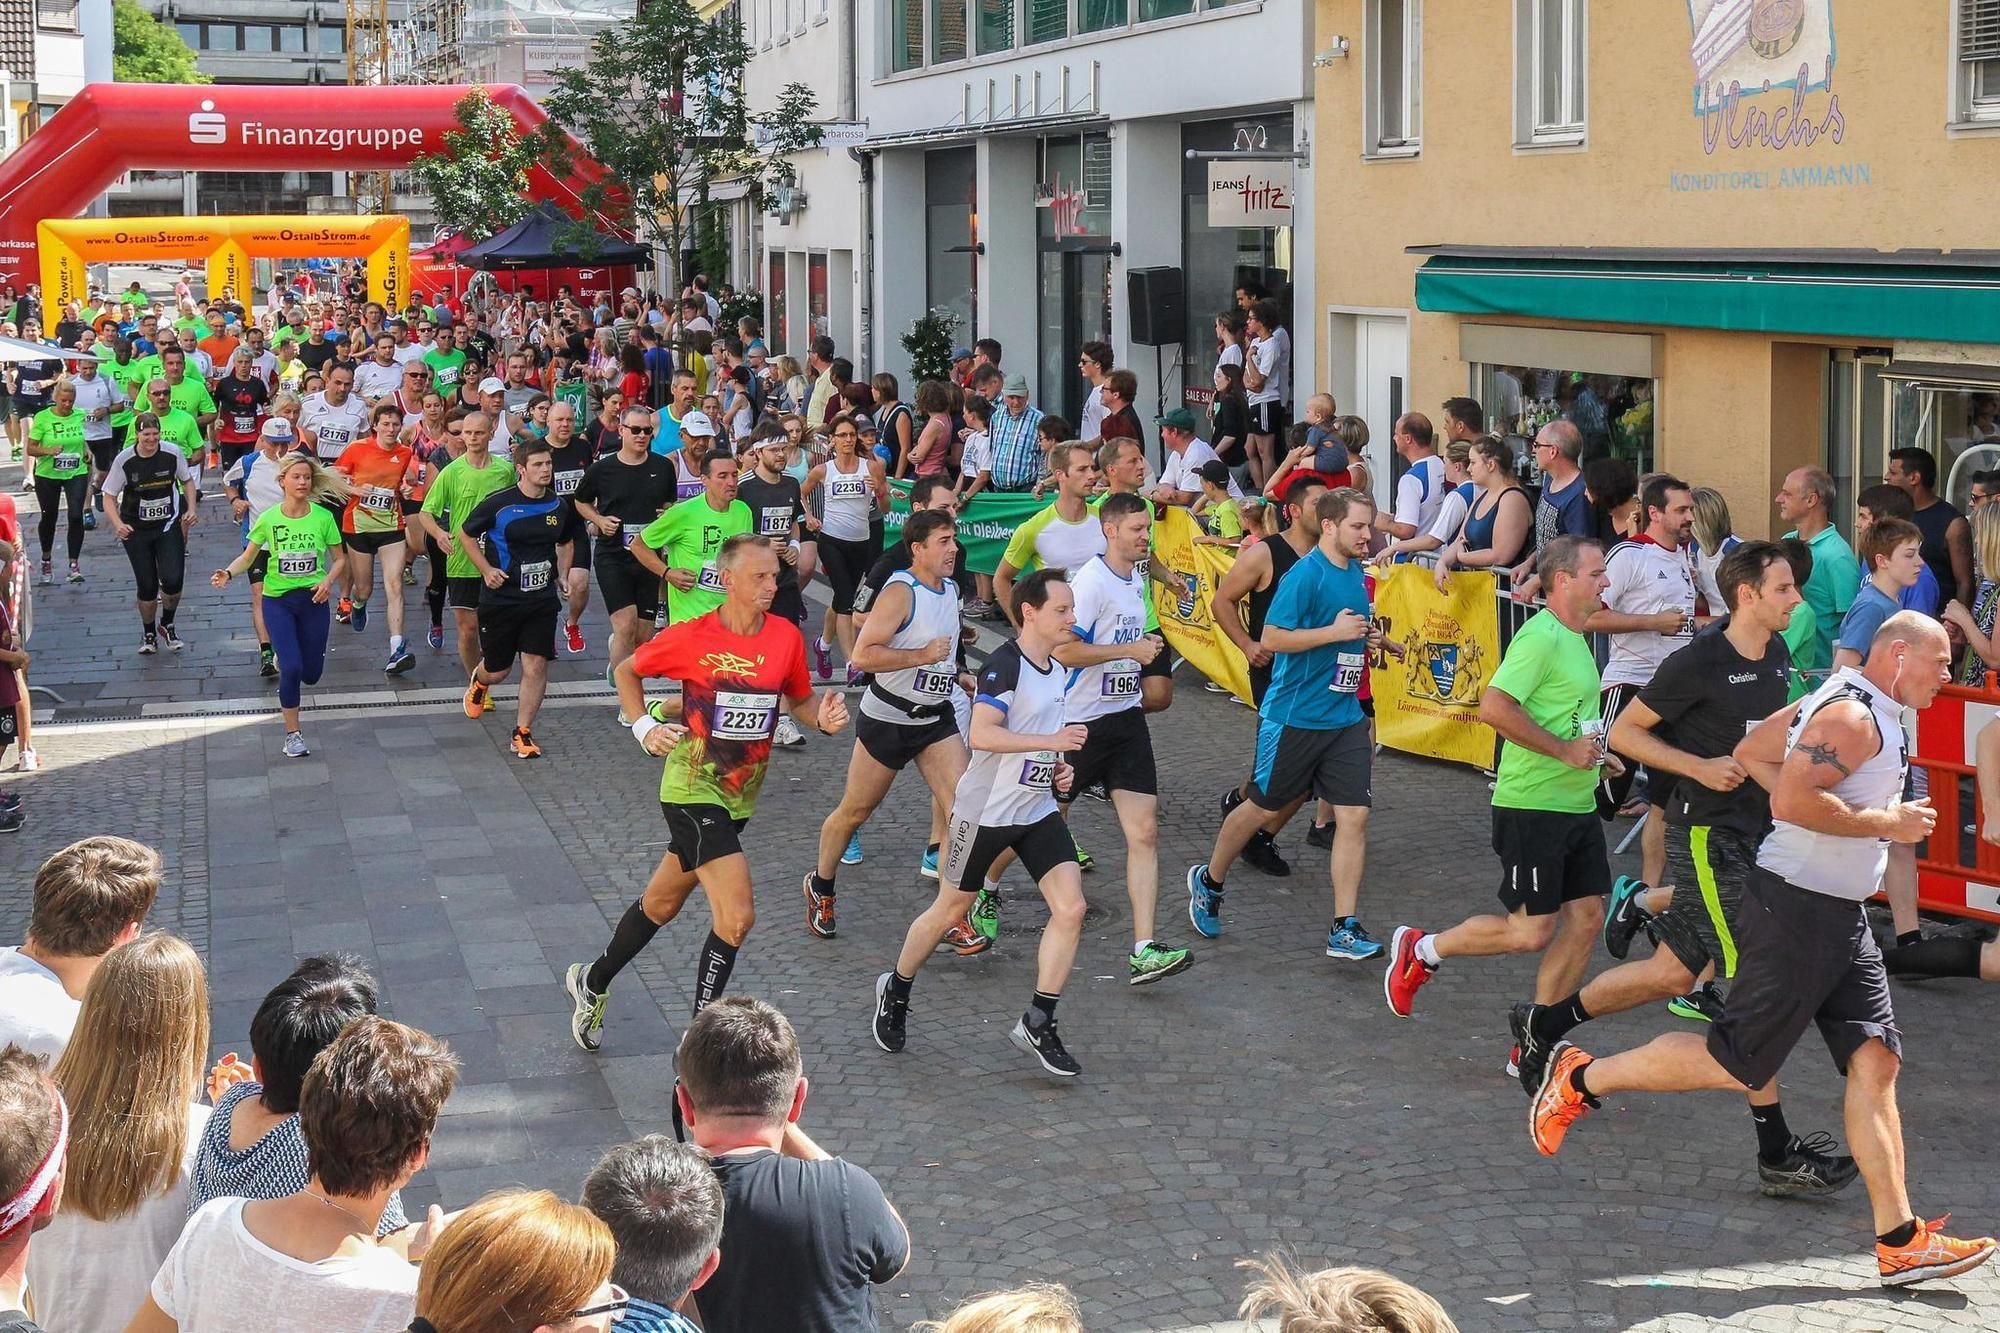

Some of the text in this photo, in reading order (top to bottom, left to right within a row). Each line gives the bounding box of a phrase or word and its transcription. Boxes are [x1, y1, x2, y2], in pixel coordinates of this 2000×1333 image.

[241, 121, 423, 151] Finanzgruppe
[1669, 163, 1871, 191] KONDITOREI AMMANN
[1212, 174, 1291, 214] JEANS fritz
[86, 231, 209, 245] www.OstalbStrom.de
[252, 229, 371, 241] www.OstalbStrom.de
[0, 239, 36, 249] arkasse
[1201, 391, 1214, 403] SAL
[323, 429, 346, 441] 2176
[56, 460, 79, 468] 2198
[559, 480, 578, 491] 187
[836, 482, 861, 493] 2236
[364, 495, 391, 509] 1619
[143, 505, 169, 517] 1890
[546, 515, 558, 526] 56
[765, 517, 792, 530] 1873
[272, 525, 315, 550] Petro
[281, 542, 315, 550] TEAM
[283, 560, 313, 572] 2197
[1115, 613, 1137, 626] Team
[920, 672, 953, 693] 1959
[1340, 669, 1361, 685] 196
[1728, 671, 1758, 684] Christian
[1108, 676, 1139, 693] 1962
[722, 711, 769, 729] 2237
[1028, 766, 1053, 783] 229
[949, 820, 970, 870] Carl Zeiss
[697, 949, 727, 1011] kalenji
